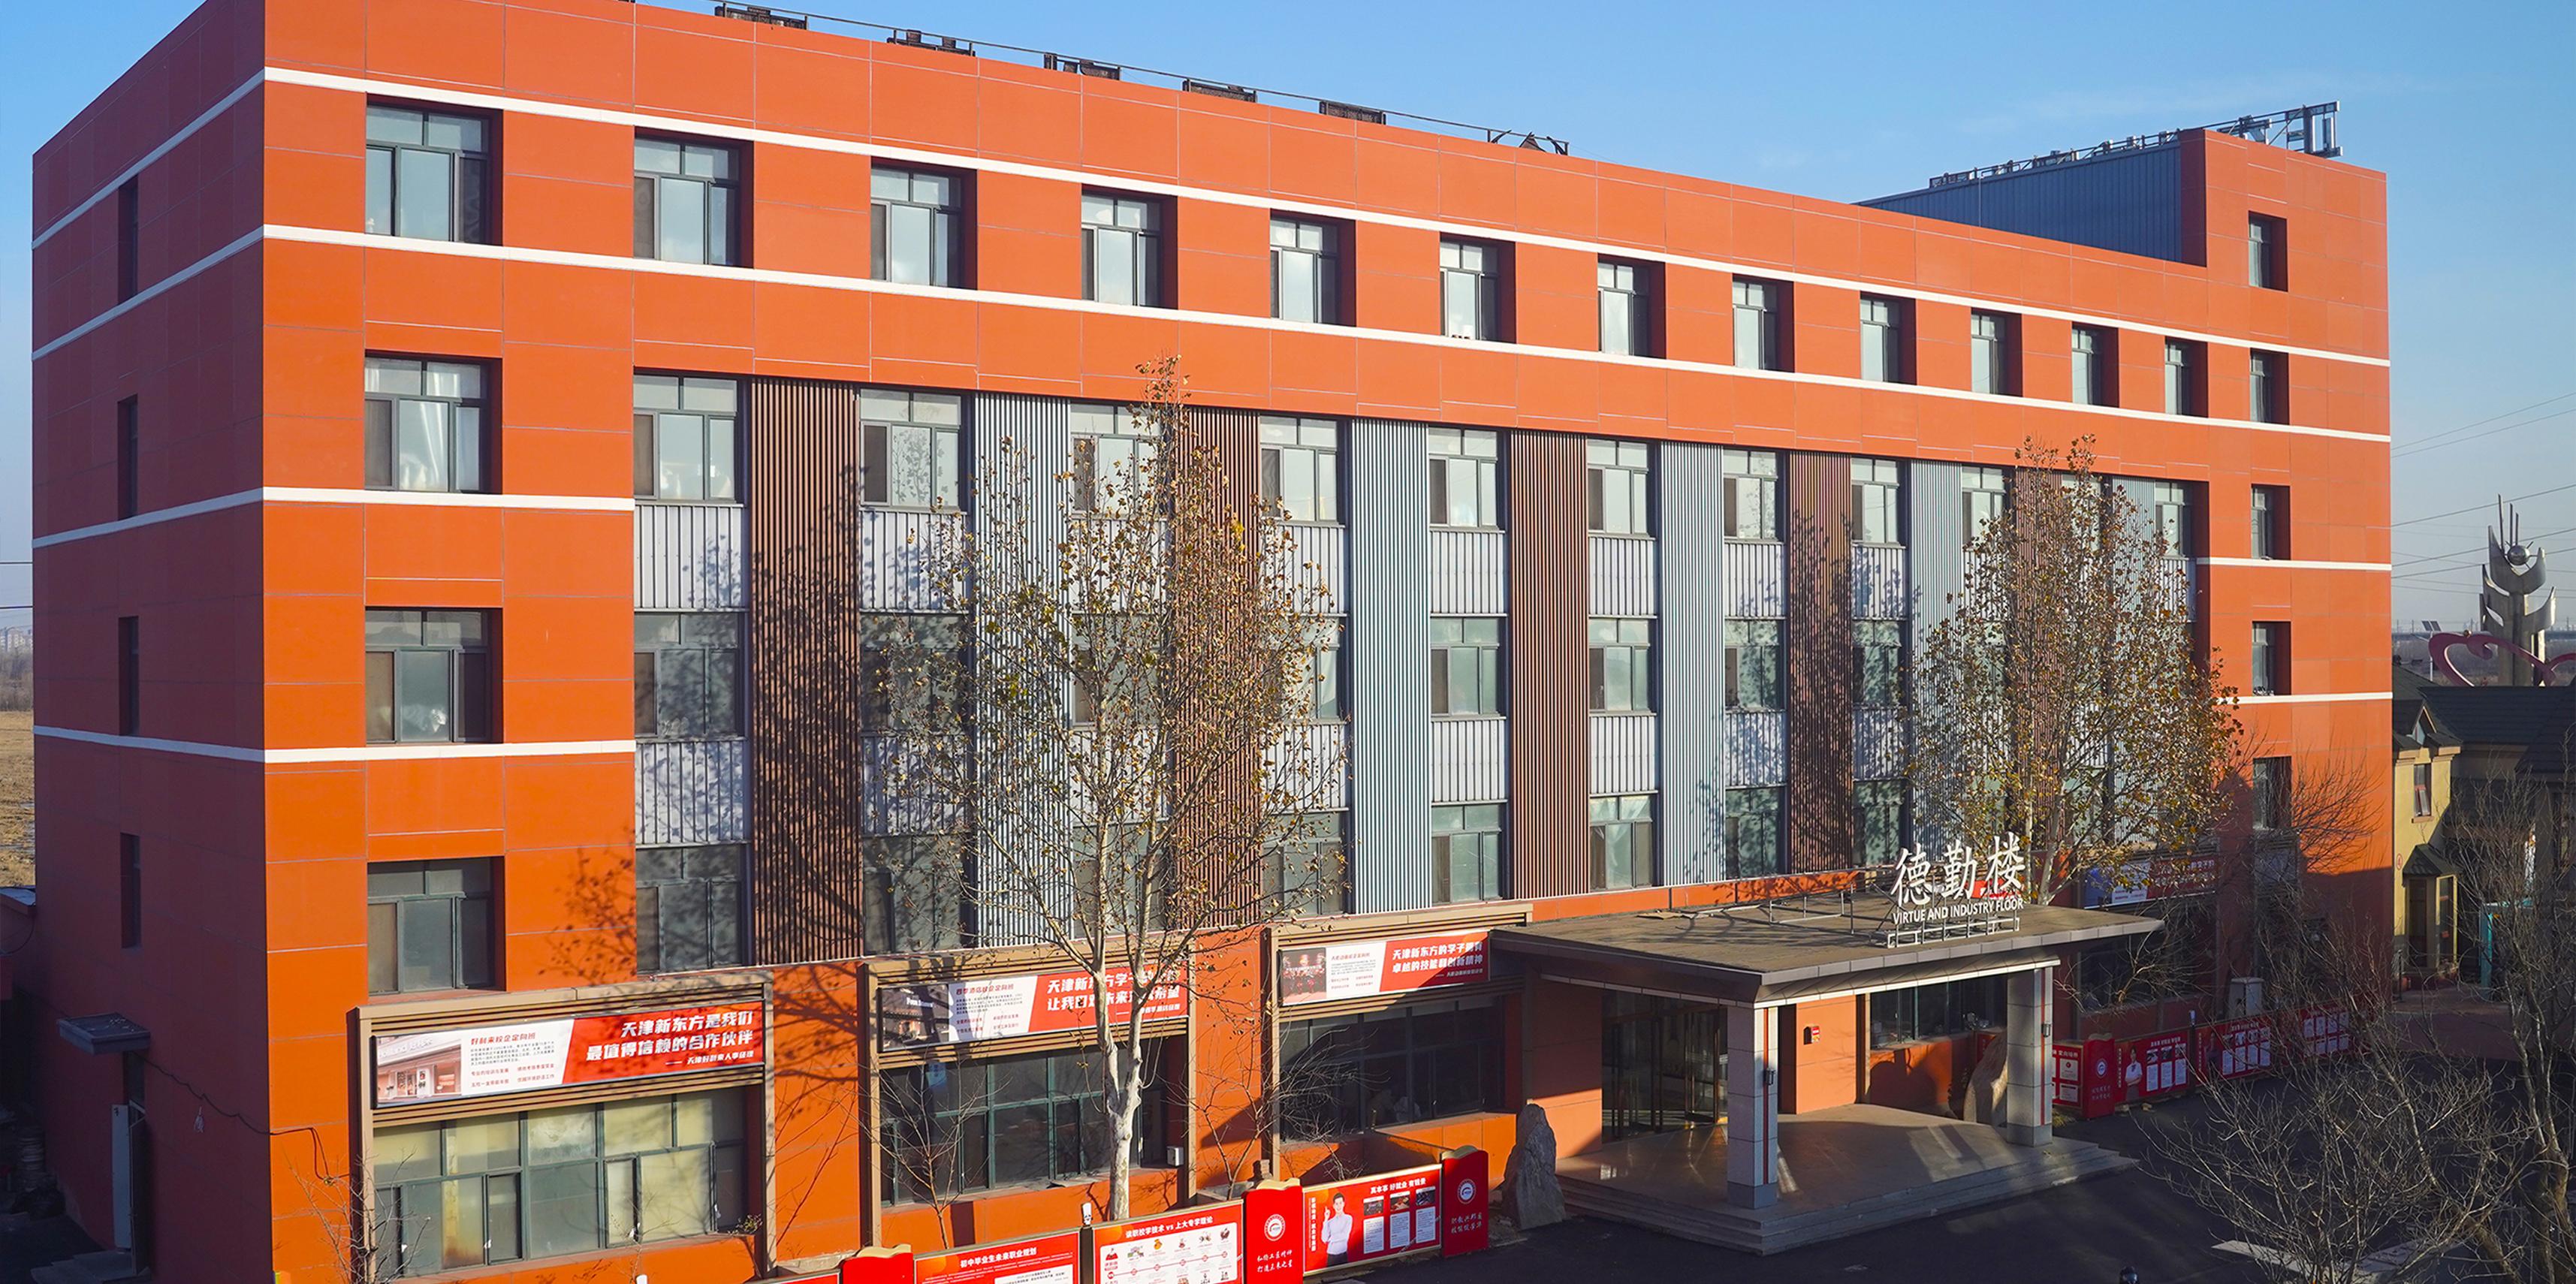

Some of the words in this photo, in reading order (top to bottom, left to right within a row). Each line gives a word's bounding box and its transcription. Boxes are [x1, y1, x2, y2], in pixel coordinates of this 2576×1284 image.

[1891, 831, 2026, 907] 德勤楼
[1893, 909, 1926, 925] VIRTUE
[1927, 906, 1948, 921] AND
[1950, 903, 1994, 918] INDUSTRY
[1995, 898, 2024, 912] FLOOR
[1392, 941, 1483, 960] 天津新东方的学子拥有
[1392, 954, 1483, 973] 卓越的技能和创新精神
[620, 1011, 754, 1038] 天津新东方是我们
[586, 1029, 754, 1061] 最值得信赖的合作伙伴
[1389, 1182, 1407, 1191] 好就业
[960, 1247, 1038, 1268] 初中毕业生未来职业规划
